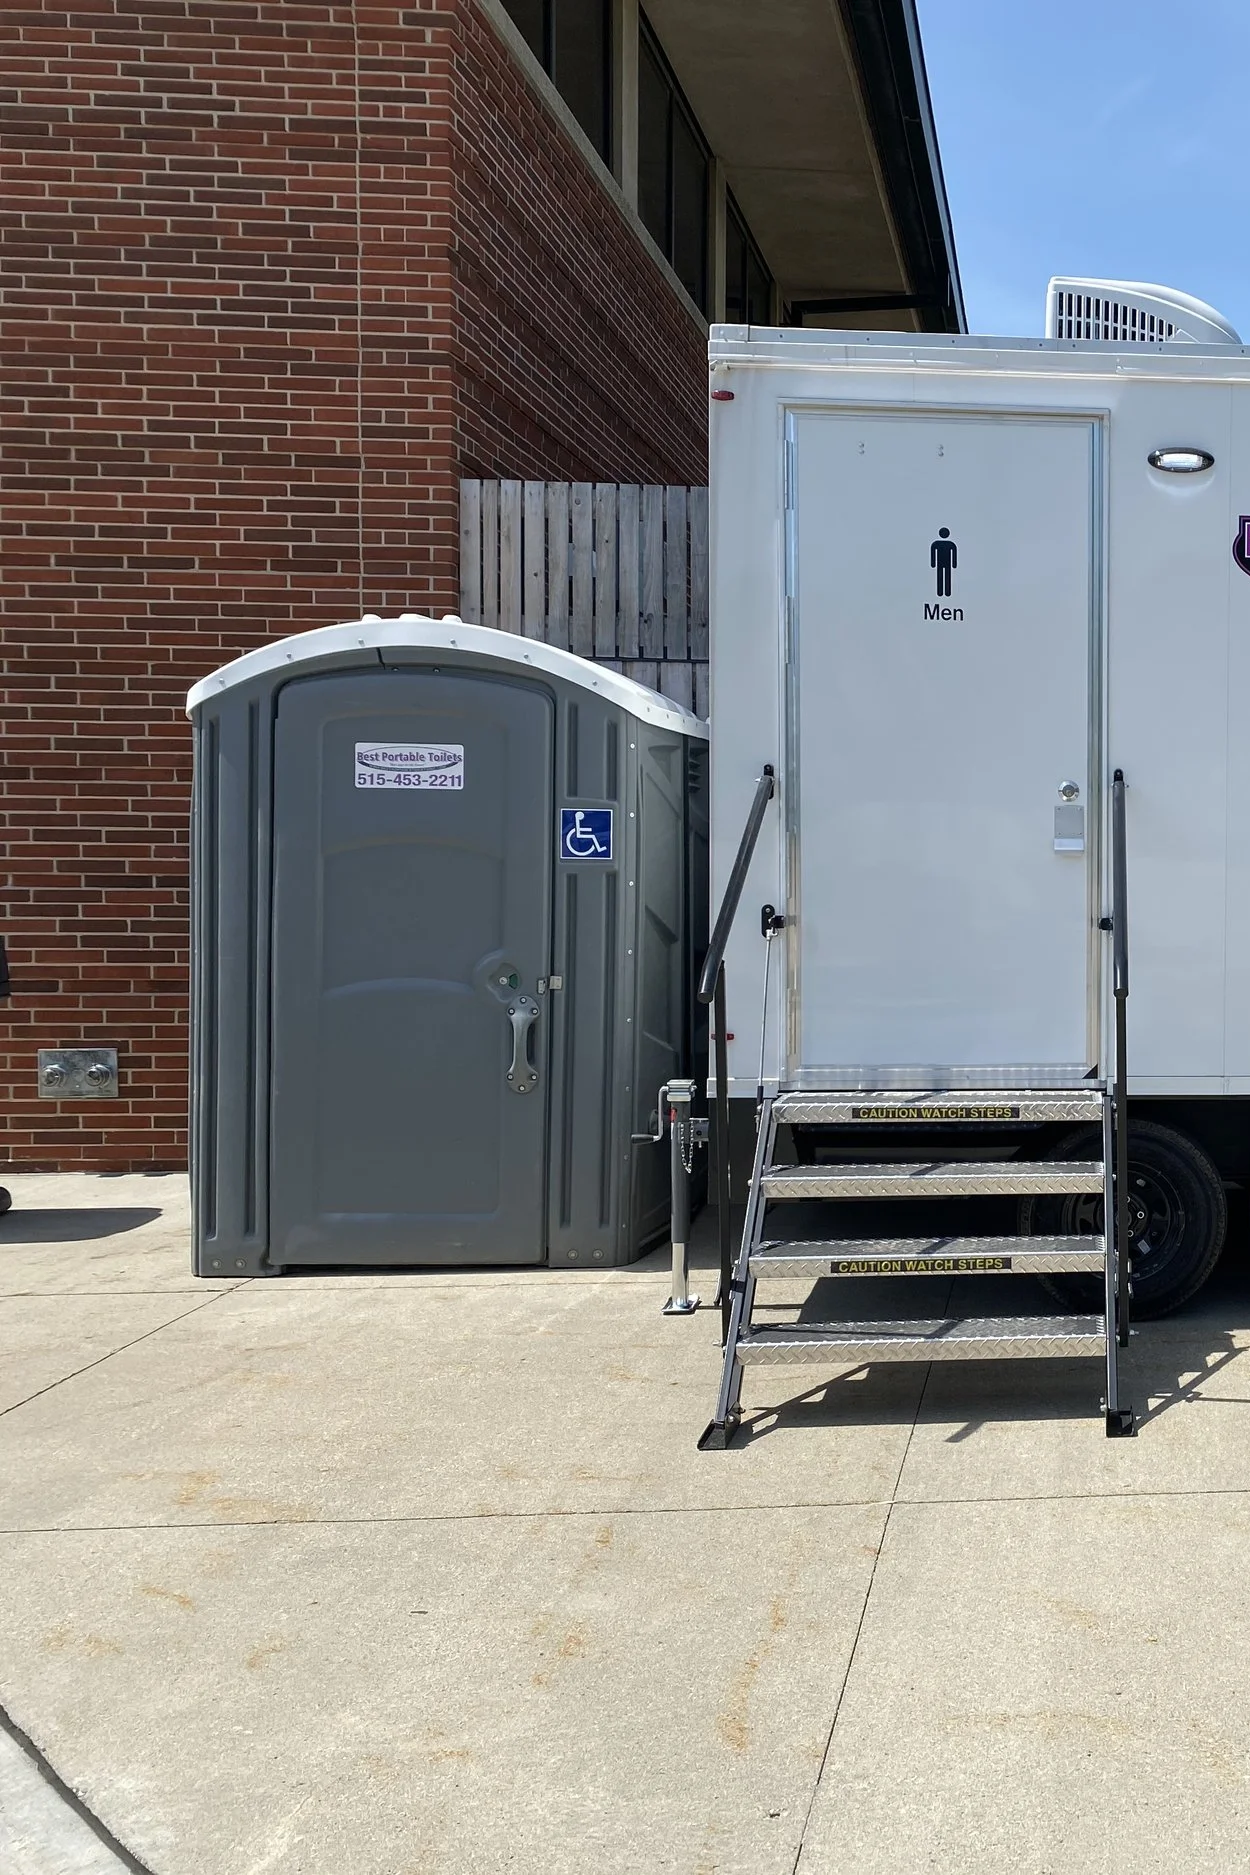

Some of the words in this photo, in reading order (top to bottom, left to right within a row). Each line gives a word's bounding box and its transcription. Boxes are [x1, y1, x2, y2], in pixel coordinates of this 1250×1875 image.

[923, 603, 964, 621] Men
[357, 752, 380, 761] Best
[381, 752, 426, 762] Portable
[428, 752, 462, 763] Toilets
[357, 773, 462, 787] 515-453-2211
[859, 1108, 918, 1118] CAUTION
[921, 1108, 966, 1118] WATCH
[970, 1108, 1012, 1118] STEPS
[838, 1261, 901, 1273] CAUTION
[905, 1259, 954, 1271] WATCH
[958, 1258, 1003, 1270] STEPS
